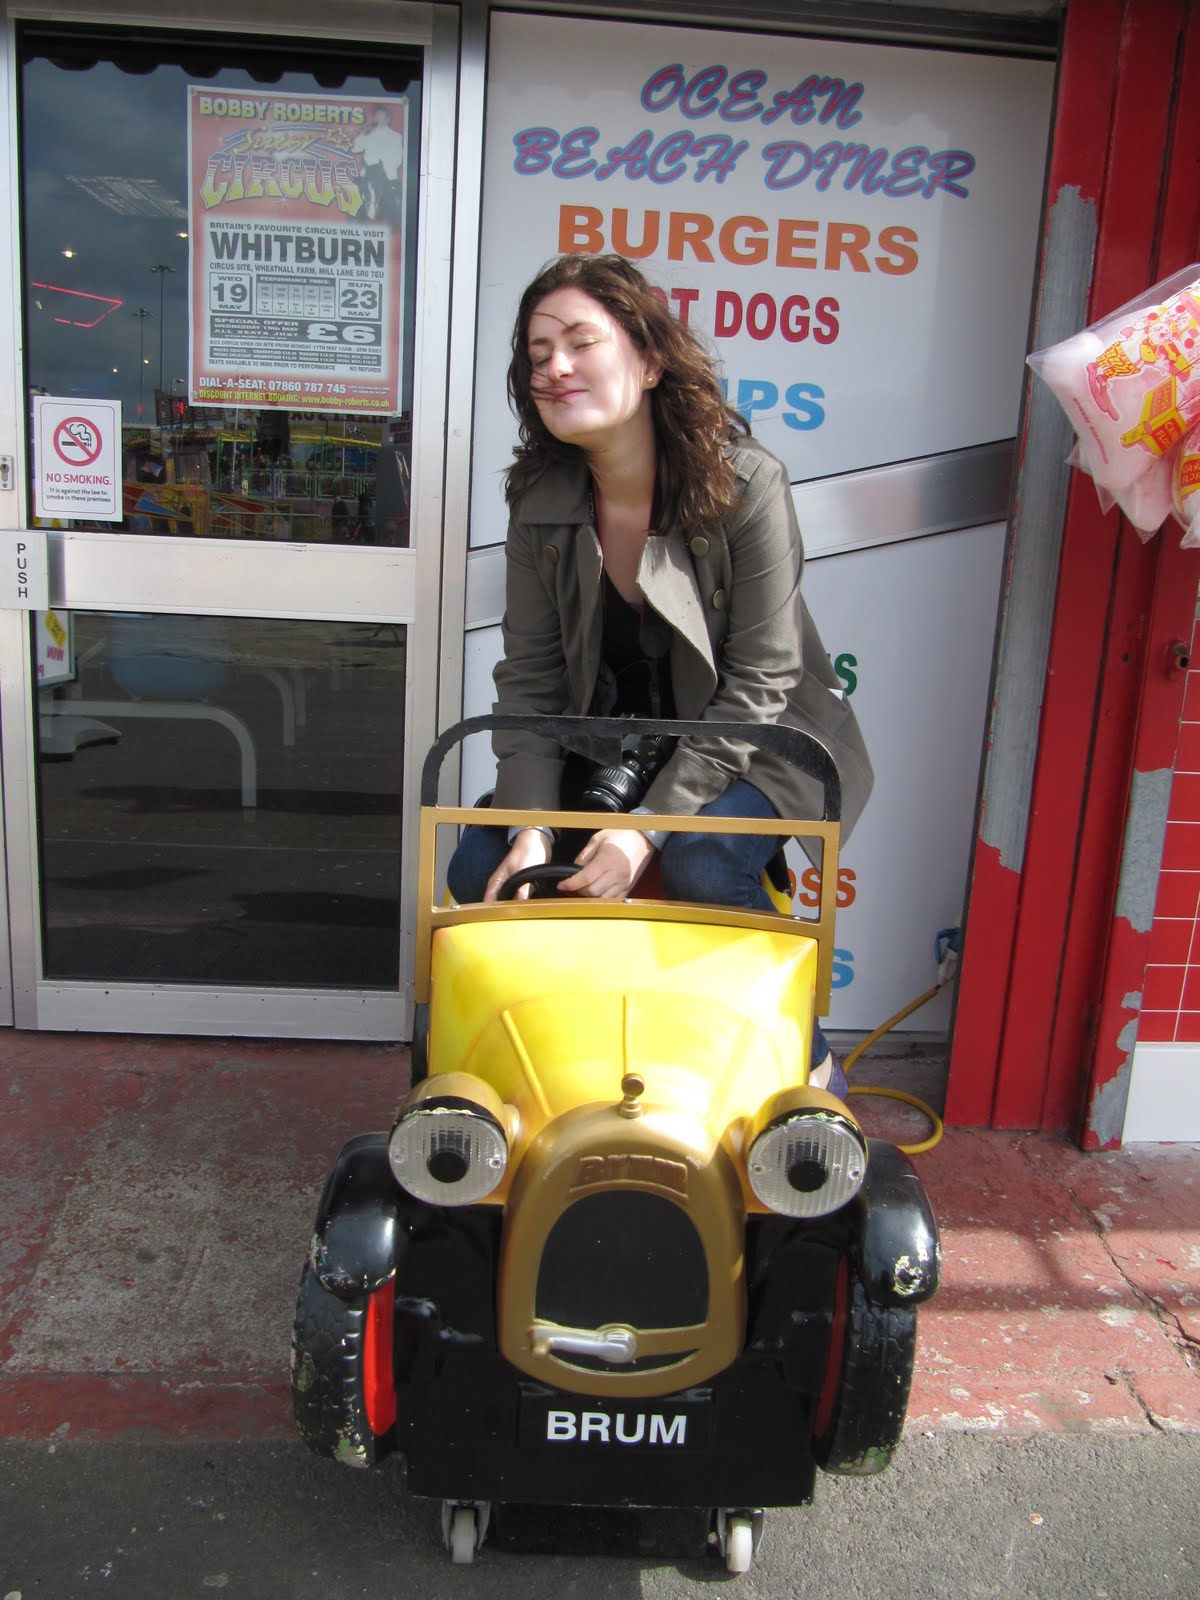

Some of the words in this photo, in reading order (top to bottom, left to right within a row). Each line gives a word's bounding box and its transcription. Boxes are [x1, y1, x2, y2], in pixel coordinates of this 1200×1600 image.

[641, 63, 865, 130] OCEAN
[199, 96, 269, 120] BOBBY
[273, 103, 366, 125] ROBERTS
[513, 125, 750, 187] BEACH
[761, 138, 976, 200] DINER
[199, 152, 363, 217] CIRCUS
[210, 222, 252, 231] BRITAIN'S
[254, 224, 303, 234] FAVOURITE
[305, 227, 338, 236] CIRCUS
[340, 229, 361, 237] WILL
[363, 230, 385, 238] VISIT
[558, 204, 920, 276] BURGERS
[210, 231, 385, 268] WHITBURN
[210, 262, 235, 271] CIRCUS
[236, 263, 253, 272] SITE,
[255, 264, 295, 274] WHEATHALL
[296, 266, 318, 275] FARM,
[318, 267, 335, 276] MILL
[336, 269, 354, 277] LANE
[370, 271, 384, 279] 7EU
[260, 276, 308, 284] PERFORMANCE
[212, 282, 248, 303] 19
[341, 289, 377, 310] 23
[214, 317, 261, 325] SPECIAL
[263, 319, 299, 327] OFFER
[714, 290, 840, 345] DOGS
[307, 323, 376, 344] £6
[298, 363, 336, 371] PERFORMANCE
[199, 376, 266, 390] DIAL-A-SEAT:
[268, 380, 301, 392] 07860
[304, 382, 324, 393] 787
[326, 383, 346, 394] 745
[199, 389, 233, 400] DISCOUNT
[234, 391, 267, 401] INTERNET
[268, 393, 300, 403] BOOKING:
[301, 395, 390, 408] www.bobby-roberts.co.uk
[46, 473, 61, 483] NO
[63, 473, 112, 486] SMOKING.
[61, 488, 81, 497] against
[71, 494, 86, 502] these
[86, 495, 111, 503] premises
[17, 542, 28, 598] PUSH
[546, 1410, 687, 1444] BRUM
